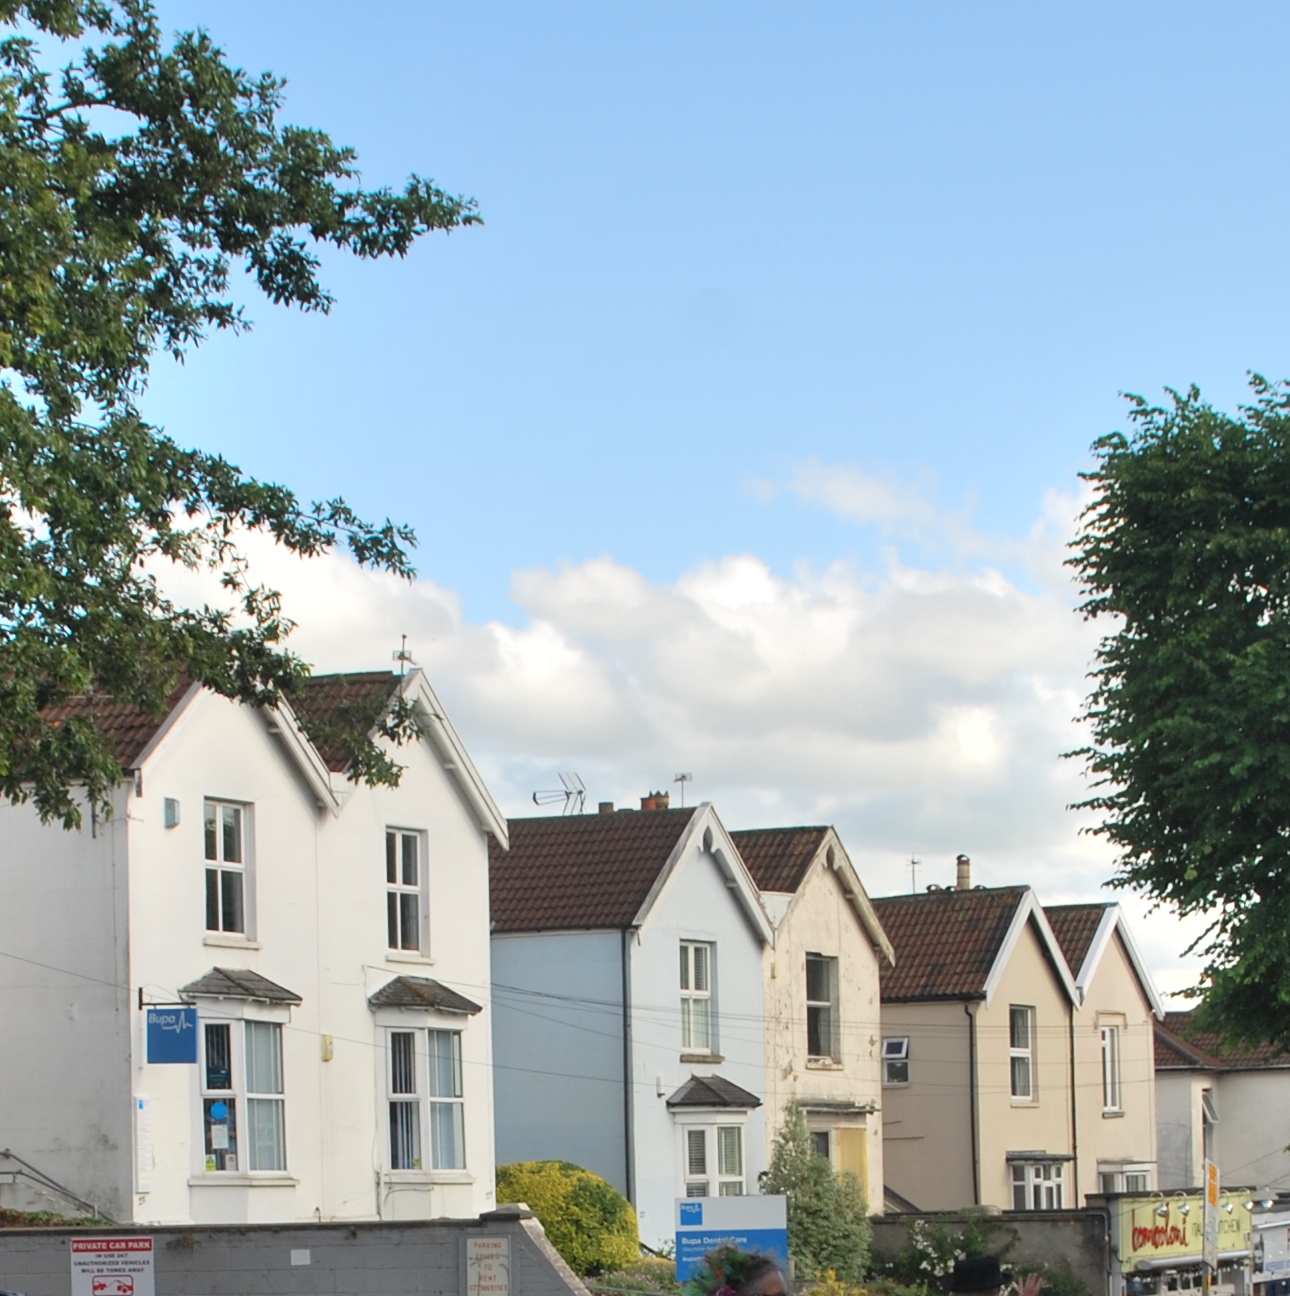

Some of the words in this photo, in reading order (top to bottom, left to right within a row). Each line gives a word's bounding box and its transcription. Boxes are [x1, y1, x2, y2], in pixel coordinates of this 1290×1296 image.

[149, 1012, 176, 1026] Bupa
[73, 1242, 107, 1250] PRIVATE
[109, 1241, 127, 1249] CAR
[128, 1241, 150, 1249] PARK
[473, 1241, 502, 1249] PARKING
